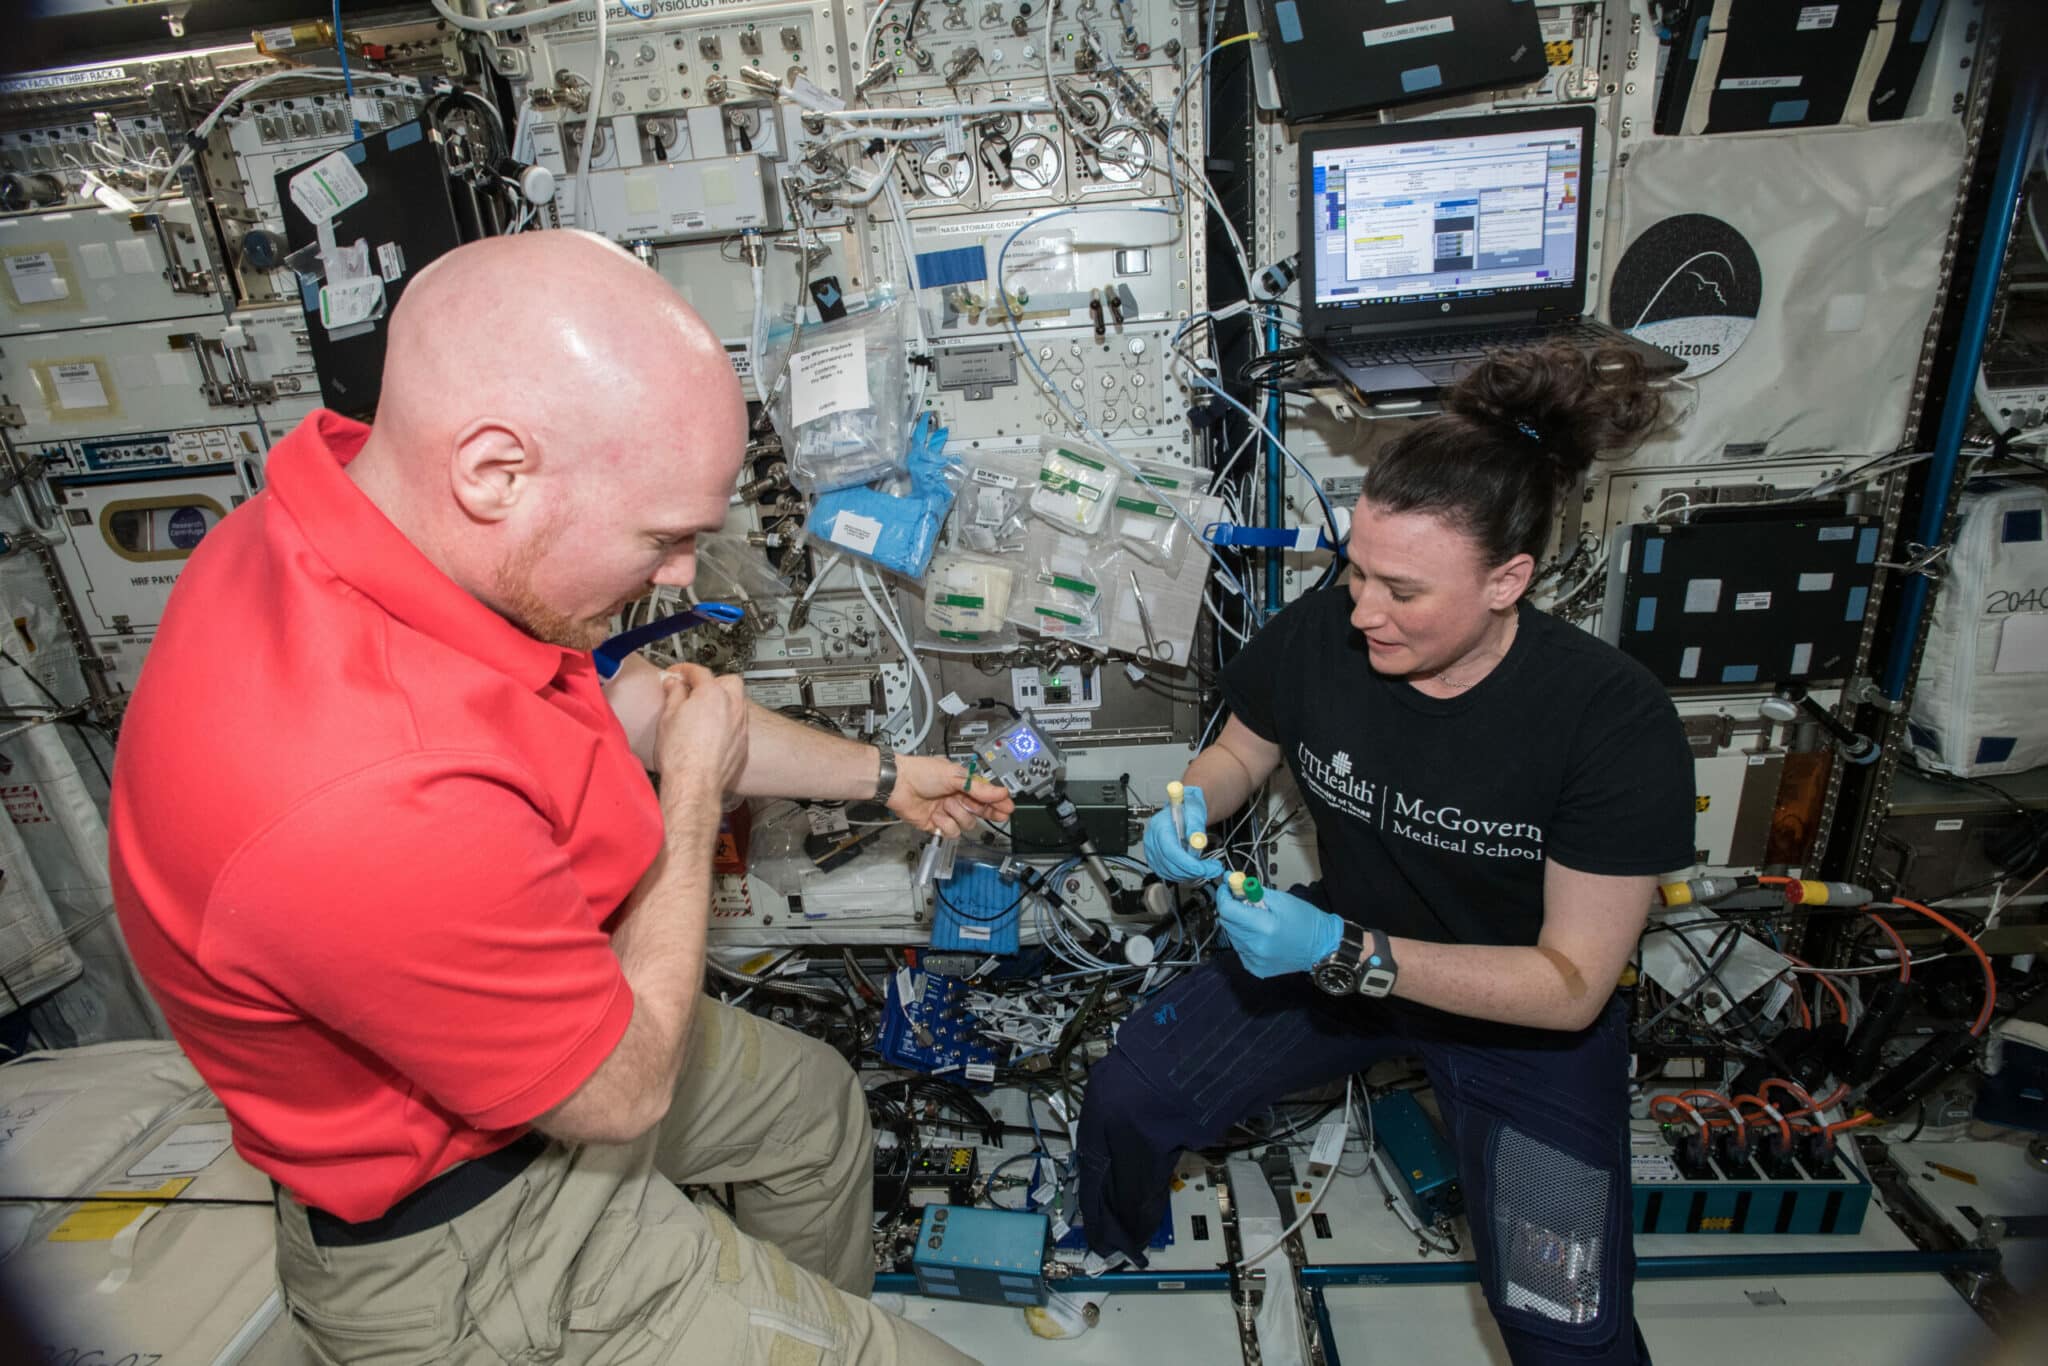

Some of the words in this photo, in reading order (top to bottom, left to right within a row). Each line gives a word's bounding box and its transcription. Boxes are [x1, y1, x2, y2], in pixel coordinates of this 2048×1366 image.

[90, 69, 114, 82] RACK
[115, 68, 122, 79] 2
[940, 225, 960, 233] NASA
[961, 222, 996, 232] STORAGE
[1654, 340, 1721, 357] orizons
[130, 576, 149, 587] HRF
[1298, 741, 1375, 805] UTHealth
[1393, 792, 1545, 843] McGovern
[1393, 820, 1467, 854] Medical
[1472, 842, 1543, 861] School
